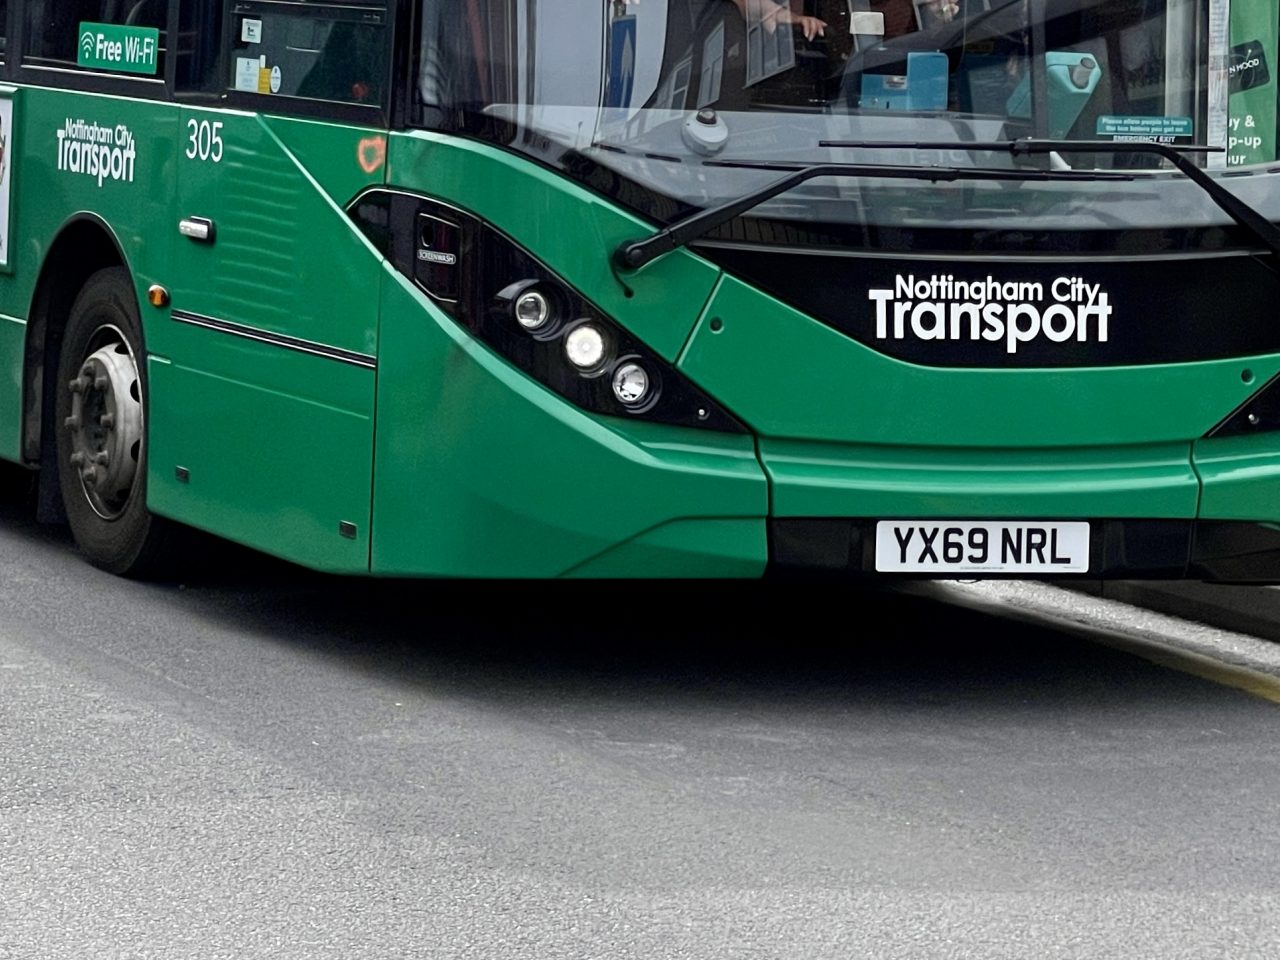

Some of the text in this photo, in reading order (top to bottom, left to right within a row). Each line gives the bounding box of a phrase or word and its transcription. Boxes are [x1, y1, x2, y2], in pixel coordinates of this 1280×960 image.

[96, 34, 154, 65] Free Wi-Fi
[1236, 58, 1260, 72] HOOD
[65, 118, 132, 147] Nottingham City
[185, 119, 223, 163] 305
[57, 129, 136, 187] Transport
[895, 274, 1100, 306] Nottingham City
[868, 289, 1112, 353] Transport
[894, 527, 1071, 564] YX69 NRL
